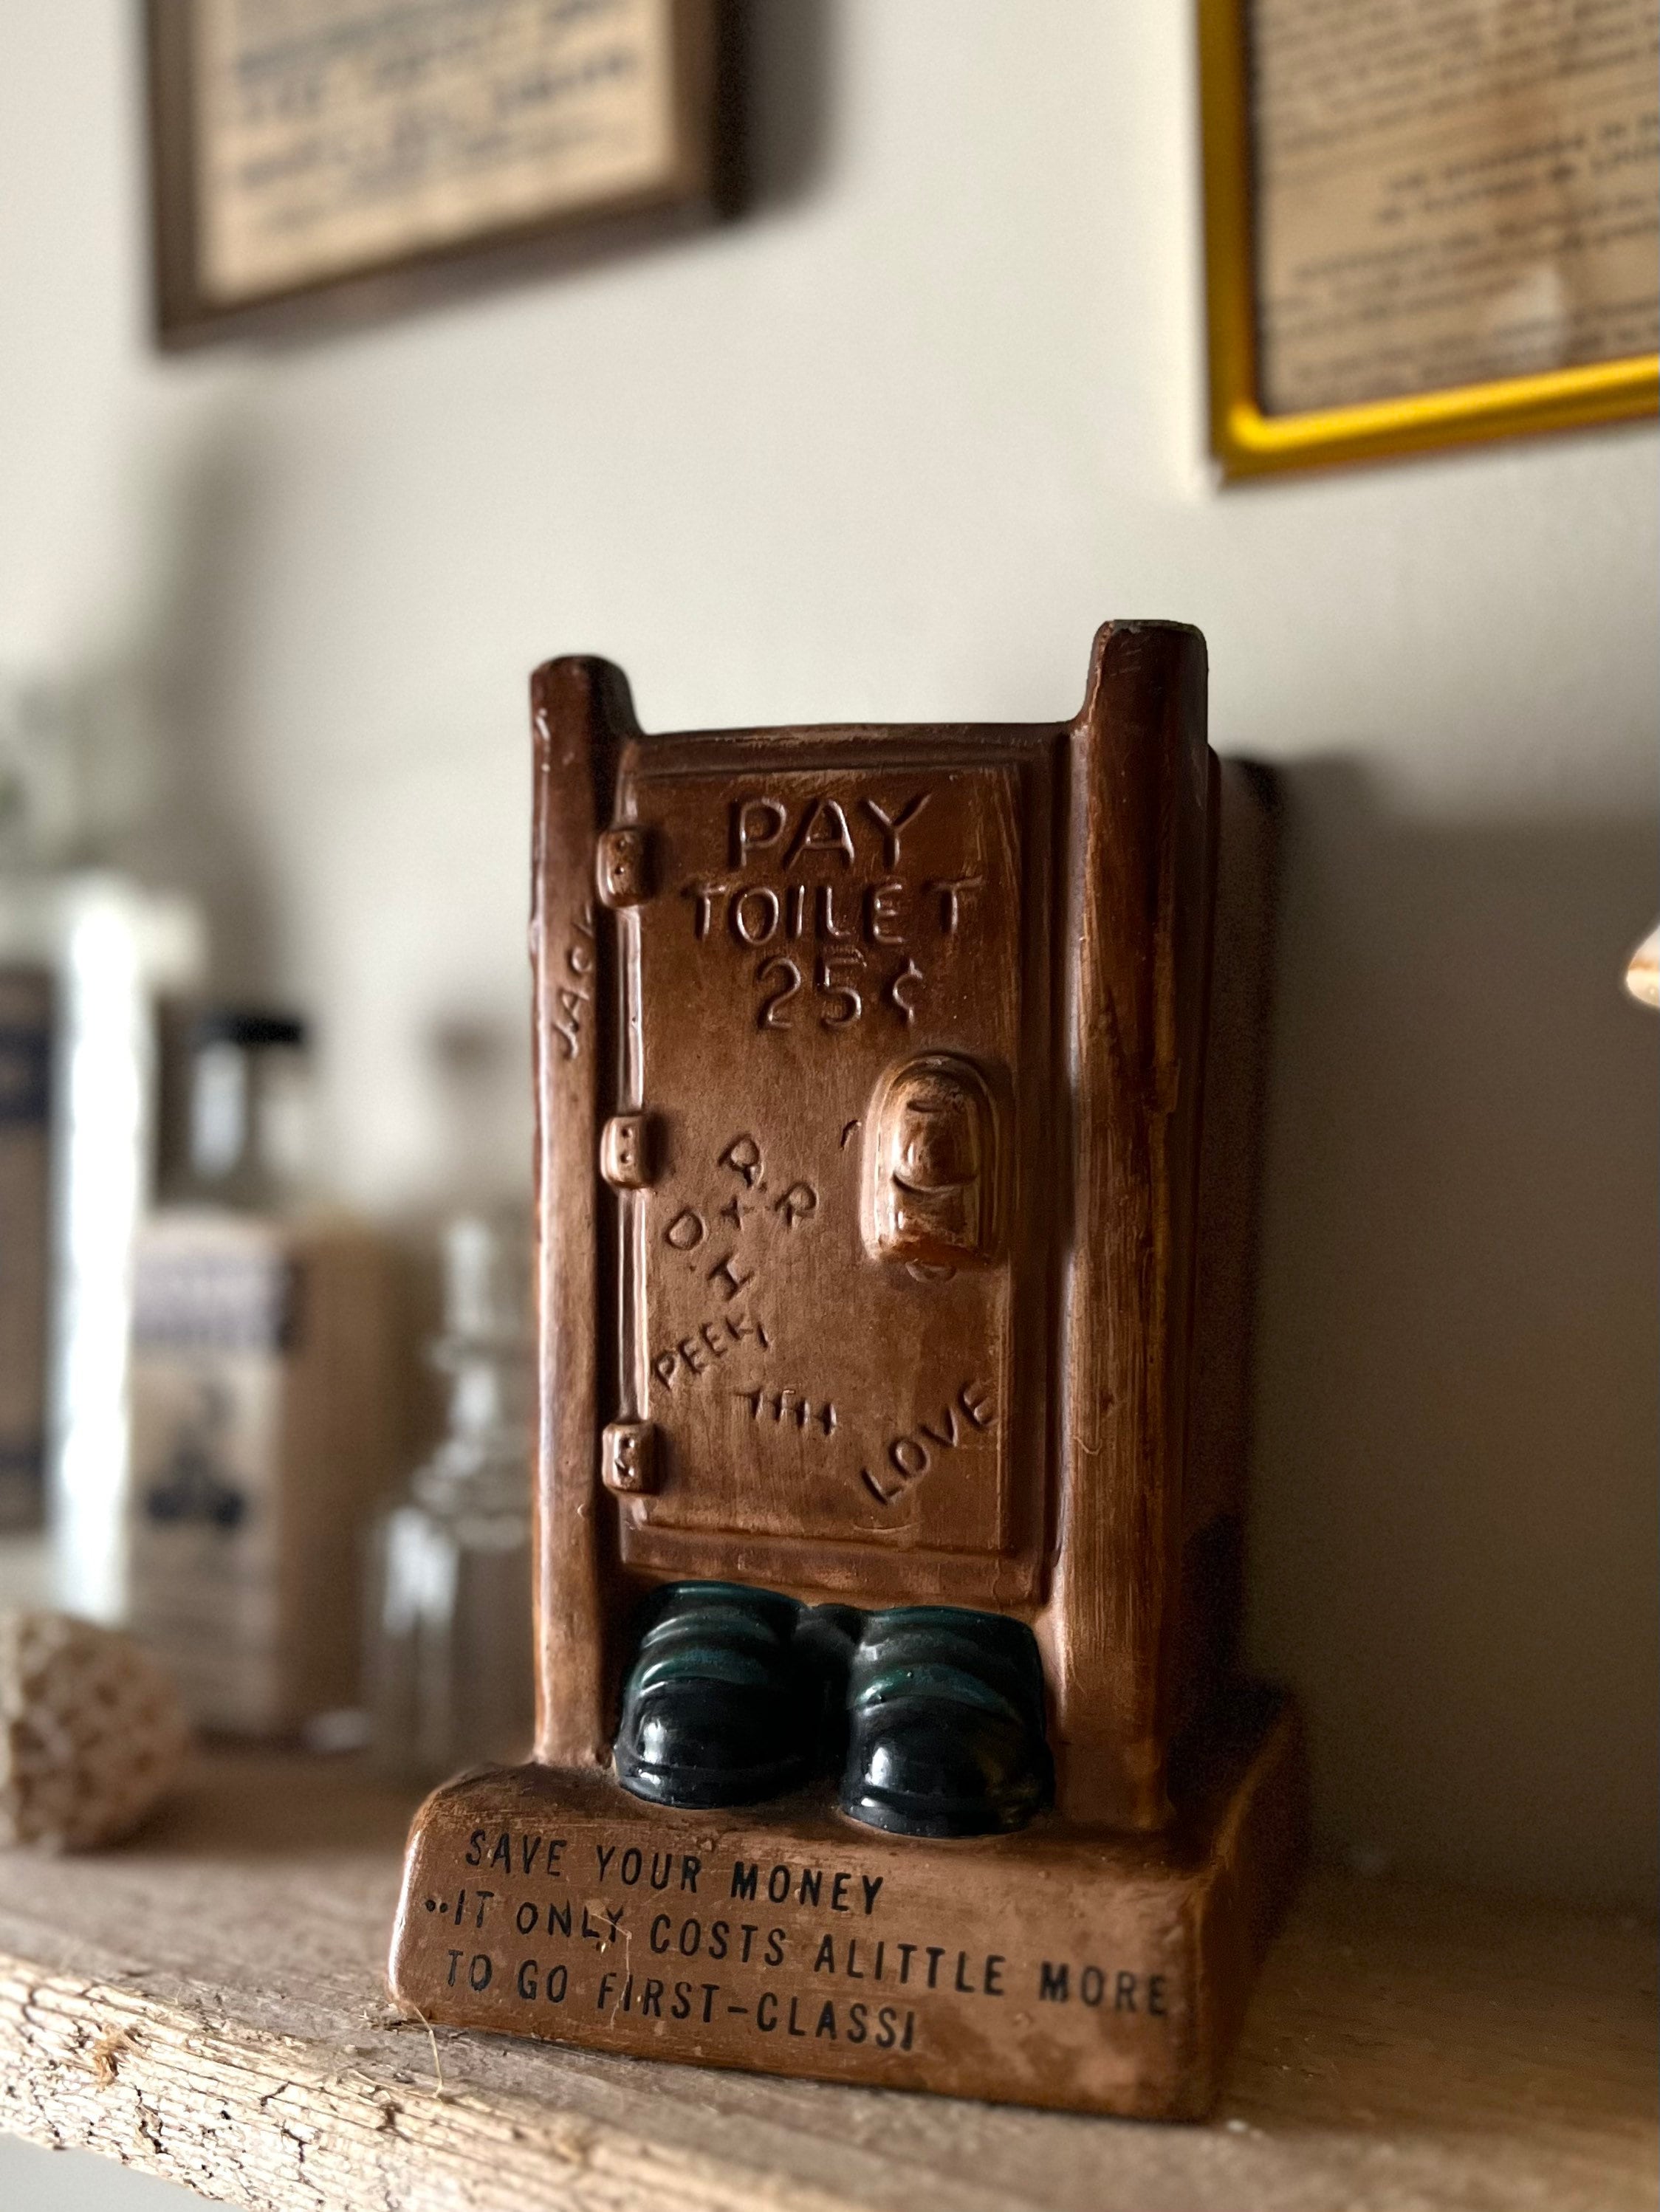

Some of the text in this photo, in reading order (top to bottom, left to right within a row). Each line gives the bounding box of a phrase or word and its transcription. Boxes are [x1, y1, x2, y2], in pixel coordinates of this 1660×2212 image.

[730, 792, 933, 870] PAY
[681, 876, 984, 945] TOILET
[861, 1381, 999, 1506] LOVE
[465, 1829, 884, 1915] SAVE YOUR MONEY
[447, 1949, 493, 1991] TO
[518, 1959, 567, 2003] GO
[516, 1899, 623, 1943] ONLY
[650, 1914, 786, 1967] COSTS
[1040, 1960, 1168, 2017] MORE
